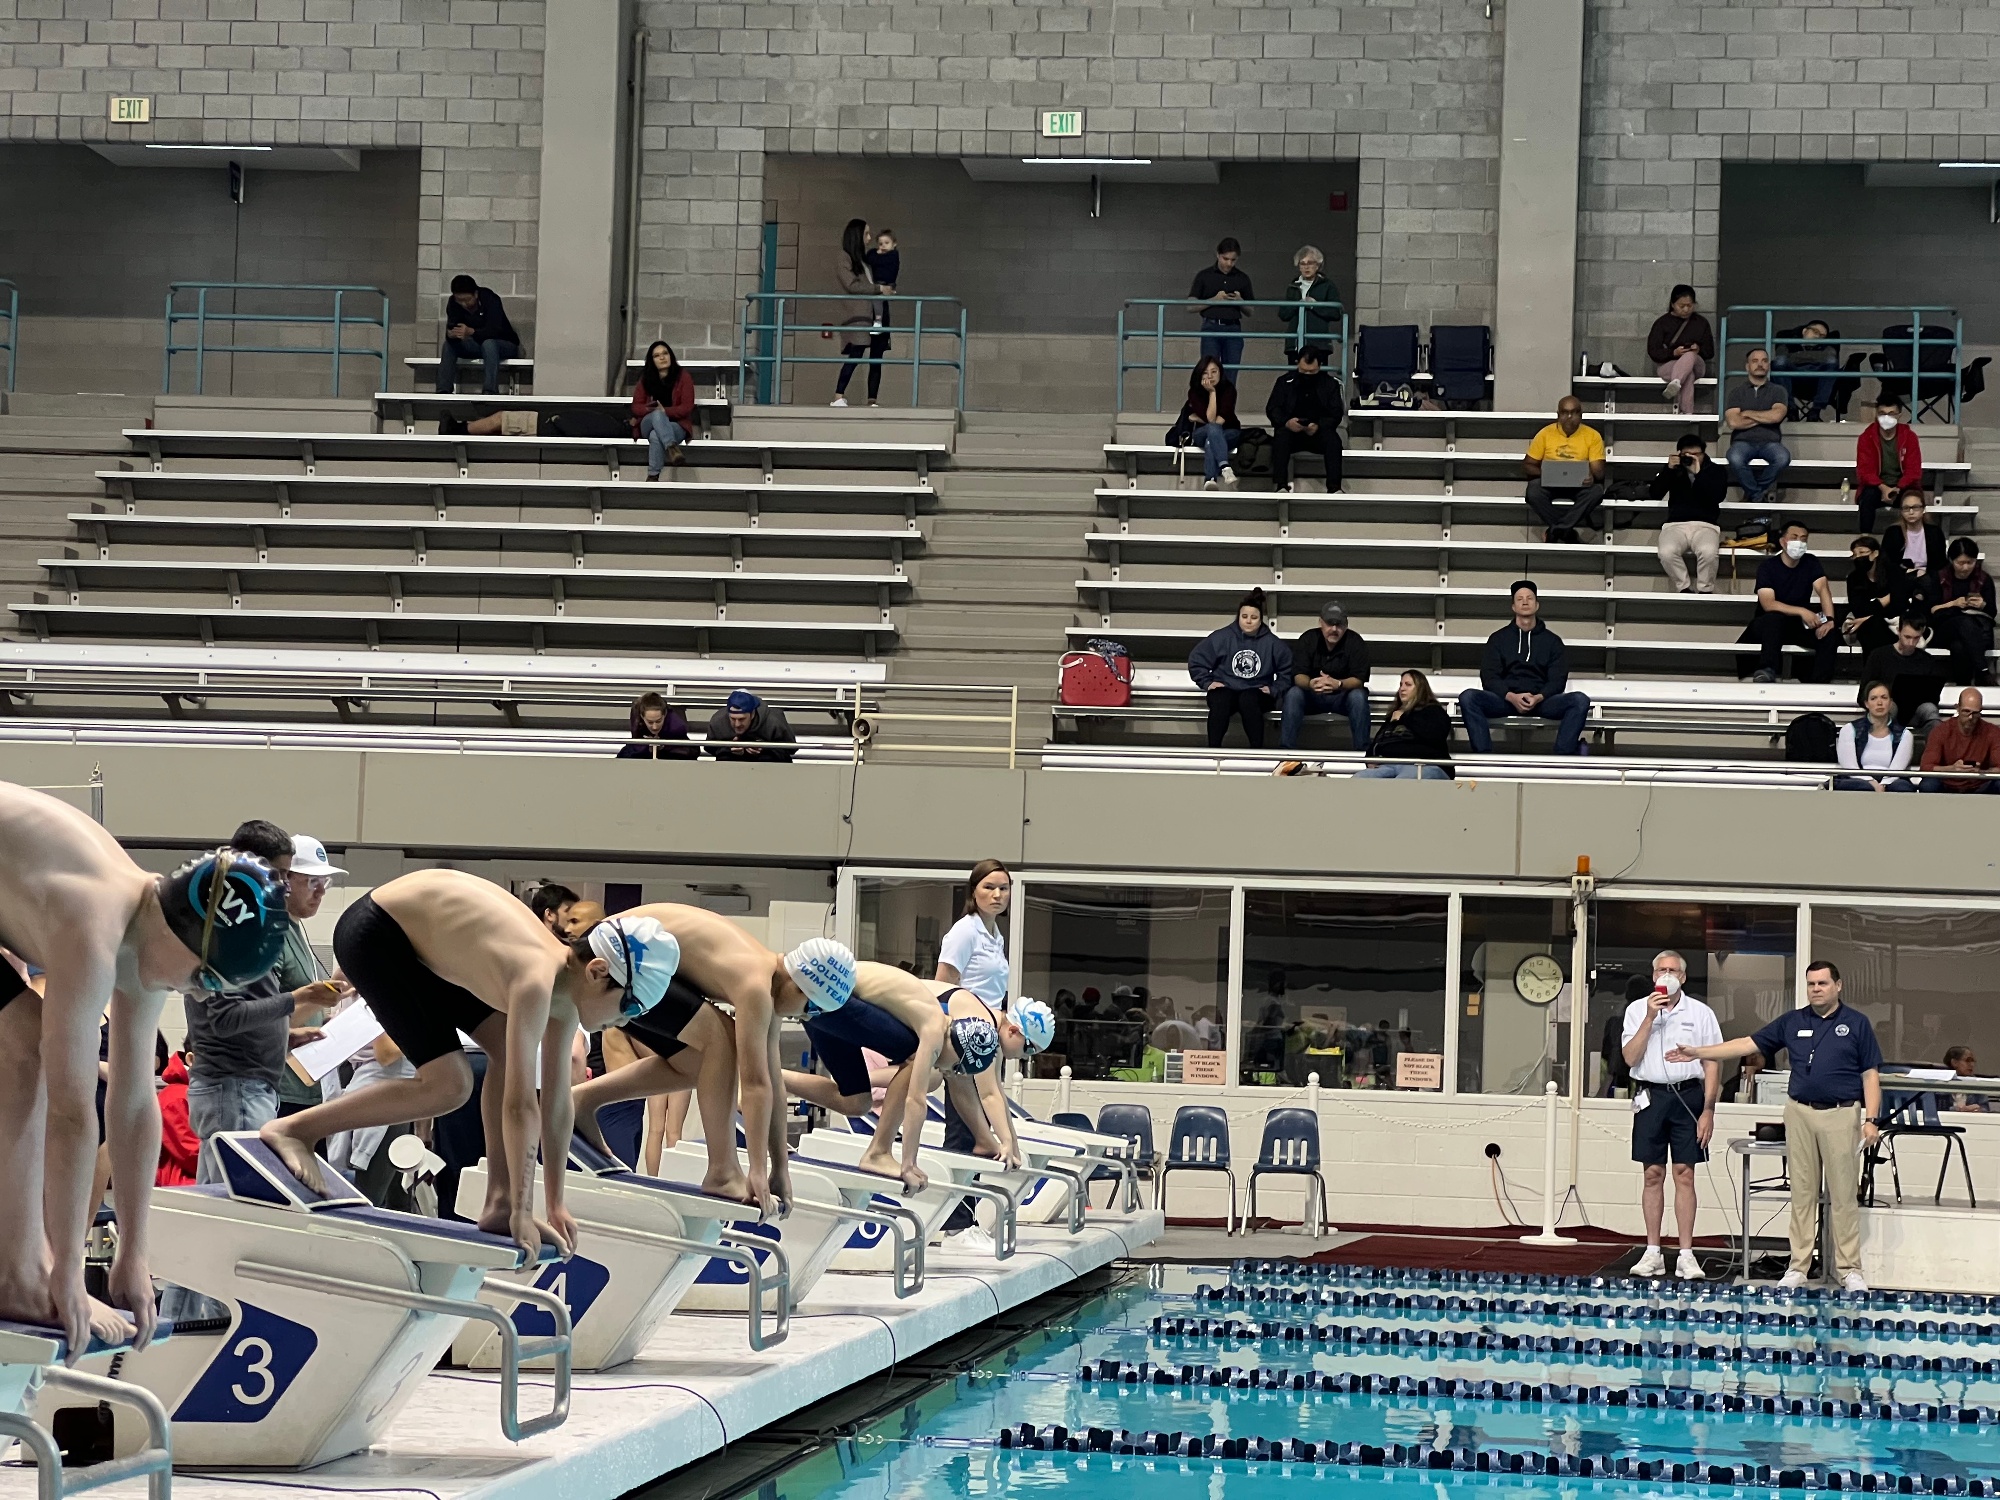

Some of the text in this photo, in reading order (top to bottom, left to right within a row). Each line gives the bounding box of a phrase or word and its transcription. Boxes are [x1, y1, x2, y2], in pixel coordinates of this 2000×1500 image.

[119, 100, 143, 118] EXIT
[1050, 114, 1075, 133] EXIT
[797, 962, 825, 987] SWIM
[810, 958, 850, 994] DOLPHIN
[827, 956, 850, 978] BLUE
[537, 1272, 571, 1311] 4
[231, 1336, 275, 1405] 3
[365, 1351, 424, 1423] 3
